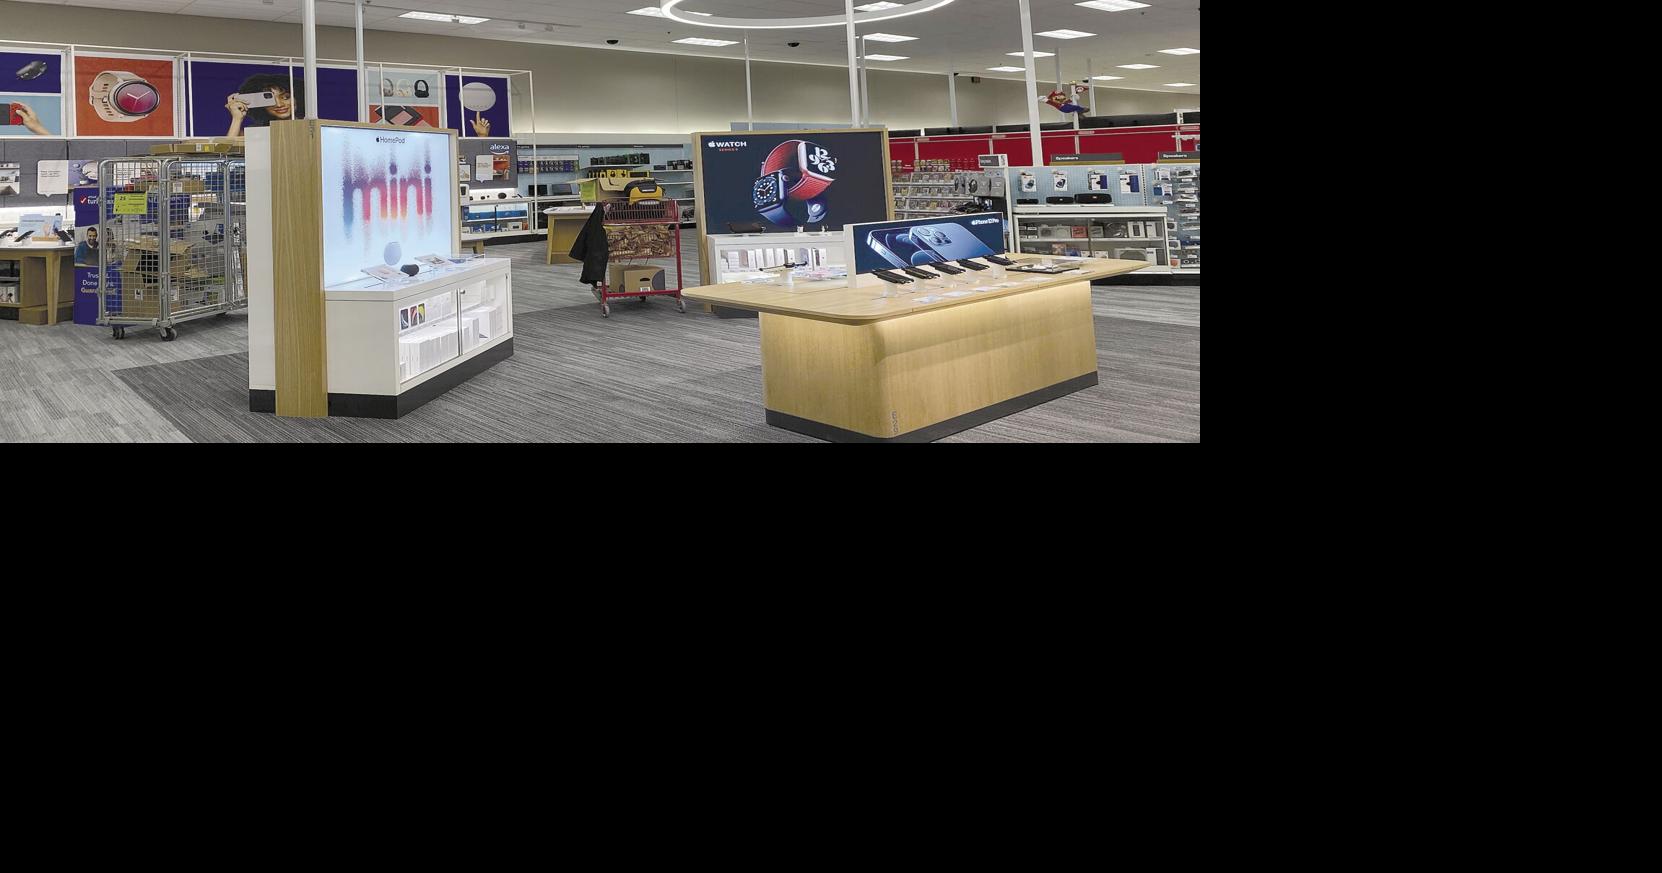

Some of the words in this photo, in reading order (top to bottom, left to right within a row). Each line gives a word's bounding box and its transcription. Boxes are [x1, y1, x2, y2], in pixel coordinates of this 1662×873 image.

[379, 136, 405, 144] HomePod
[342, 160, 433, 222] mini
[82, 279, 98, 287] Done
